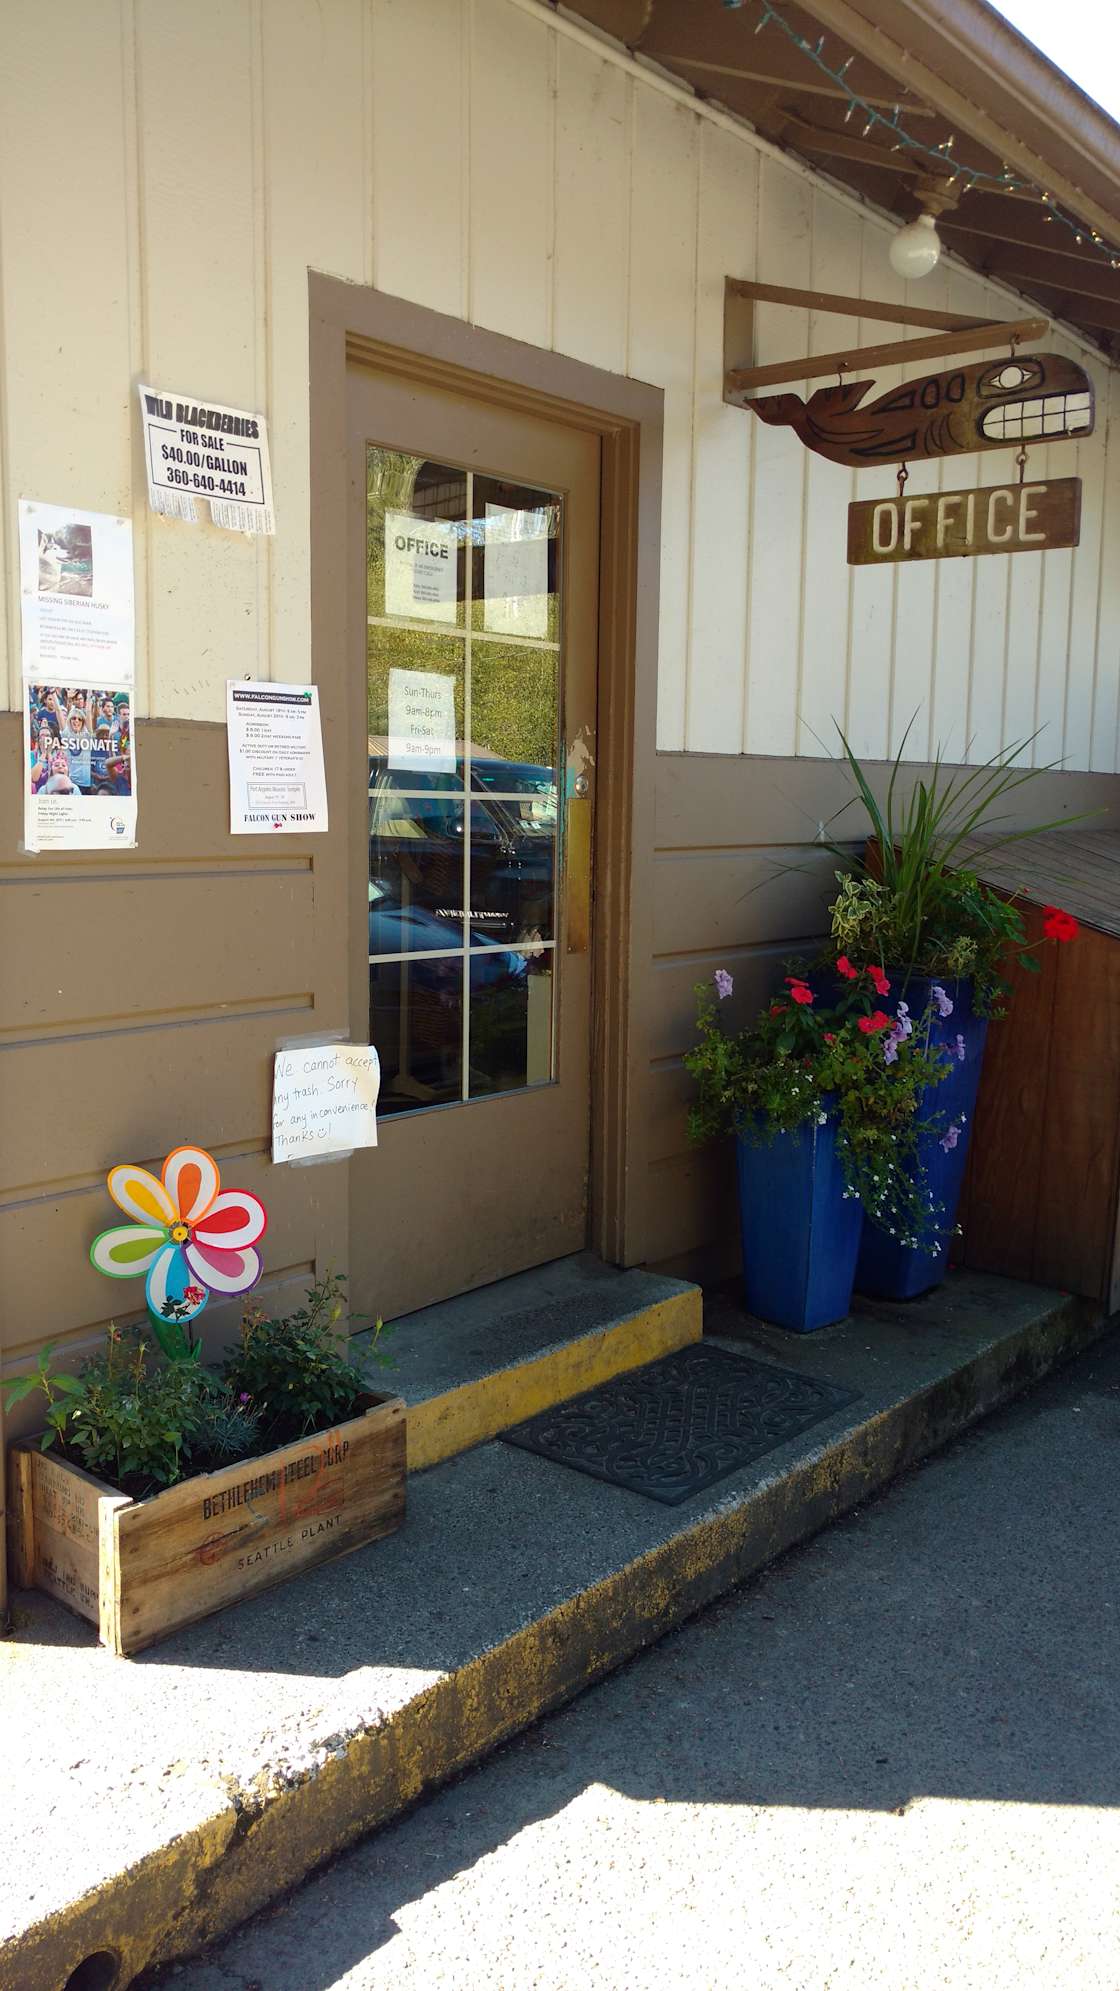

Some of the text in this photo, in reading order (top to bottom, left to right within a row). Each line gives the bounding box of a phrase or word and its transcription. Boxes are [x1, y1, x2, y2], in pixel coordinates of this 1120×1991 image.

[144, 394, 259, 439] WILD BLACKBERRIES
[180, 429, 225, 451] FOR SALE
[161, 444, 248, 476] $40.00/GALLON
[167, 467, 246, 496] 360-640-4414
[873, 485, 1048, 554] OFFICE
[395, 535, 449, 559] OFFICE
[38, 596, 63, 605] MISSING
[64, 599, 90, 608] SIBERIAN
[404, 686, 442, 700] Sun-Thurs
[405, 705, 442, 720] 9am-8pm
[410, 724, 434, 736] Fri-Sat
[44, 736, 118, 752] PASSIONATE
[406, 742, 441, 757] 9am-9pm
[244, 814, 270, 822] FALCON
[290, 813, 316, 821] SHOW
[303, 1053, 341, 1073] cannot
[327, 1076, 358, 1097] Sorry
[290, 1114, 307, 1129] any
[275, 1130, 314, 1146] Thanks
[203, 1471, 276, 1520] BETHLEHEM
[238, 1537, 293, 1570] SEATTLE
[301, 1515, 342, 1539] PLANT
